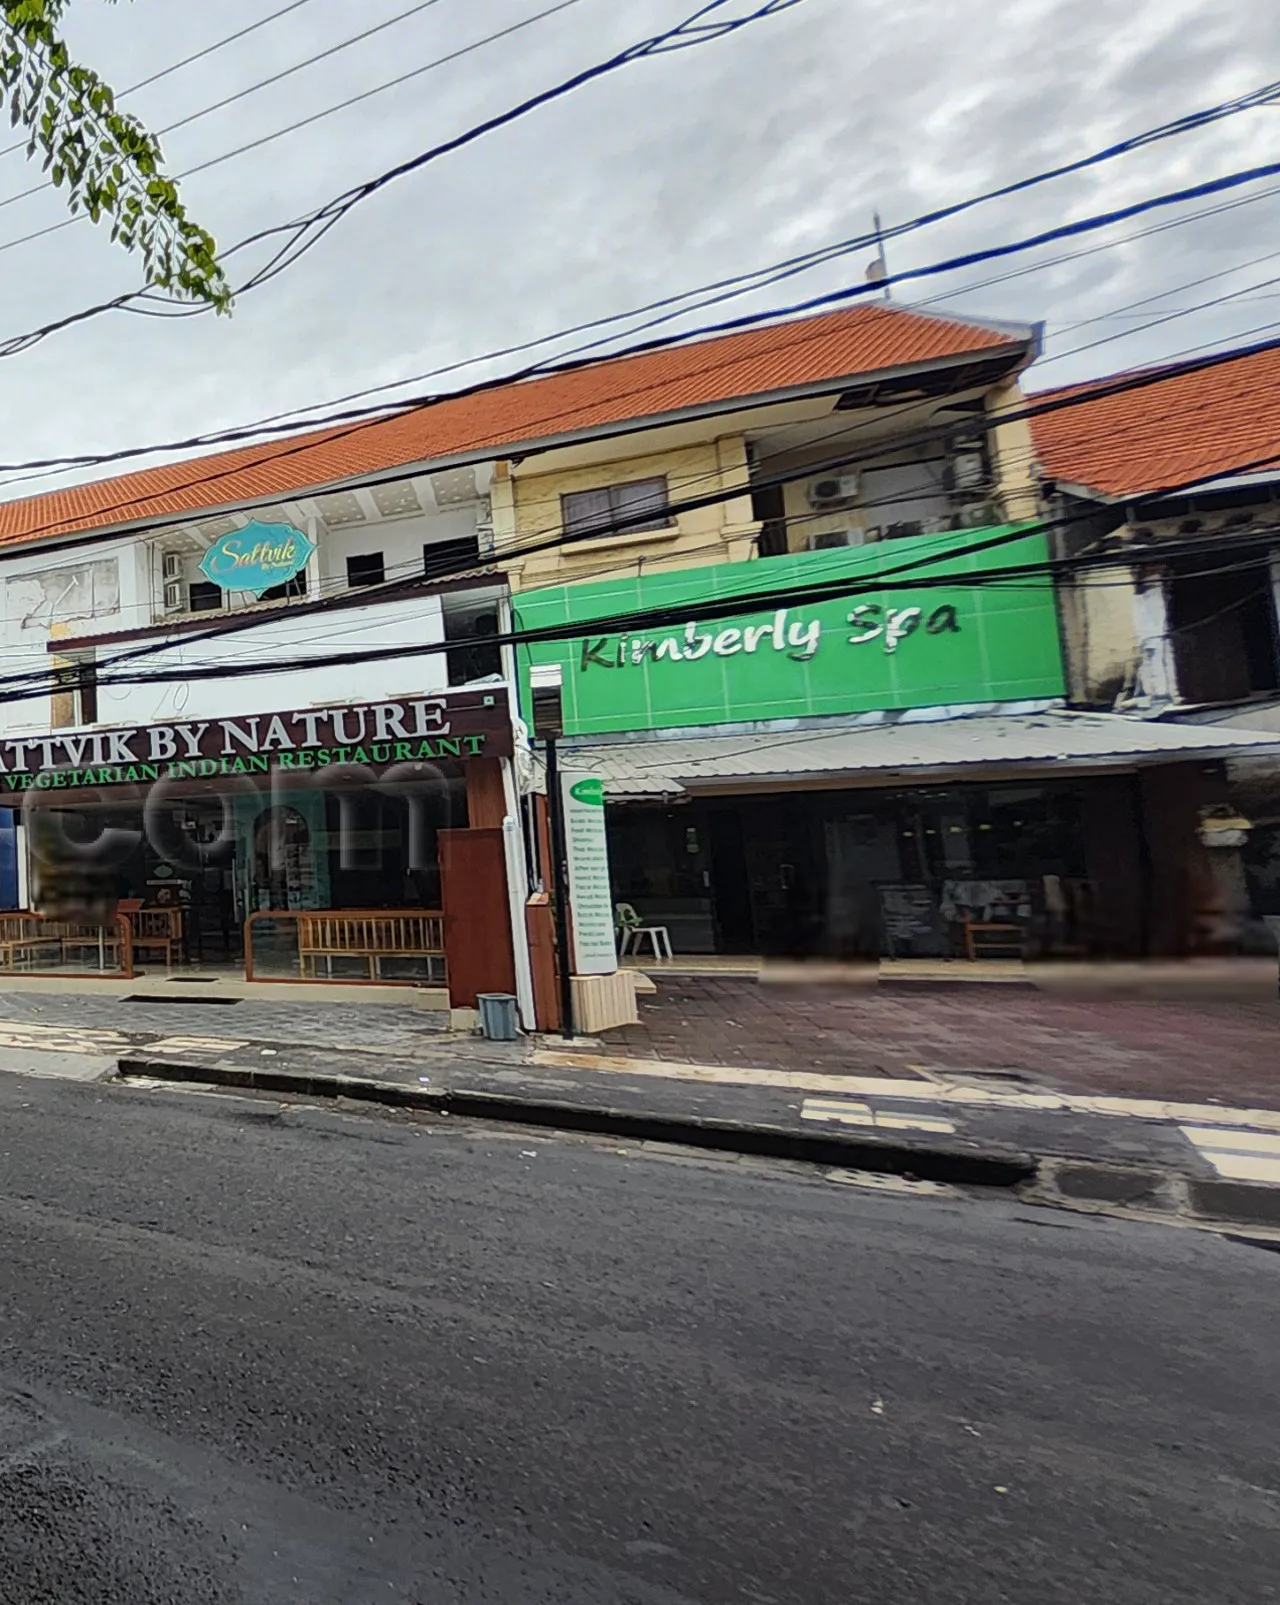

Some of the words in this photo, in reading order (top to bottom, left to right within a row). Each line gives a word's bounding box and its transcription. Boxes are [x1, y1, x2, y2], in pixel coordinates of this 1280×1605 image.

[210, 536, 297, 574] Sattvik
[580, 608, 821, 672] Kimberly
[846, 603, 962, 654] Spa
[146, 723, 210, 761] BY
[218, 699, 451, 755] NATURE
[4, 762, 160, 790] VEGETARIAN
[168, 754, 269, 779] INDIAN
[279, 734, 486, 770] RESTAURANT
